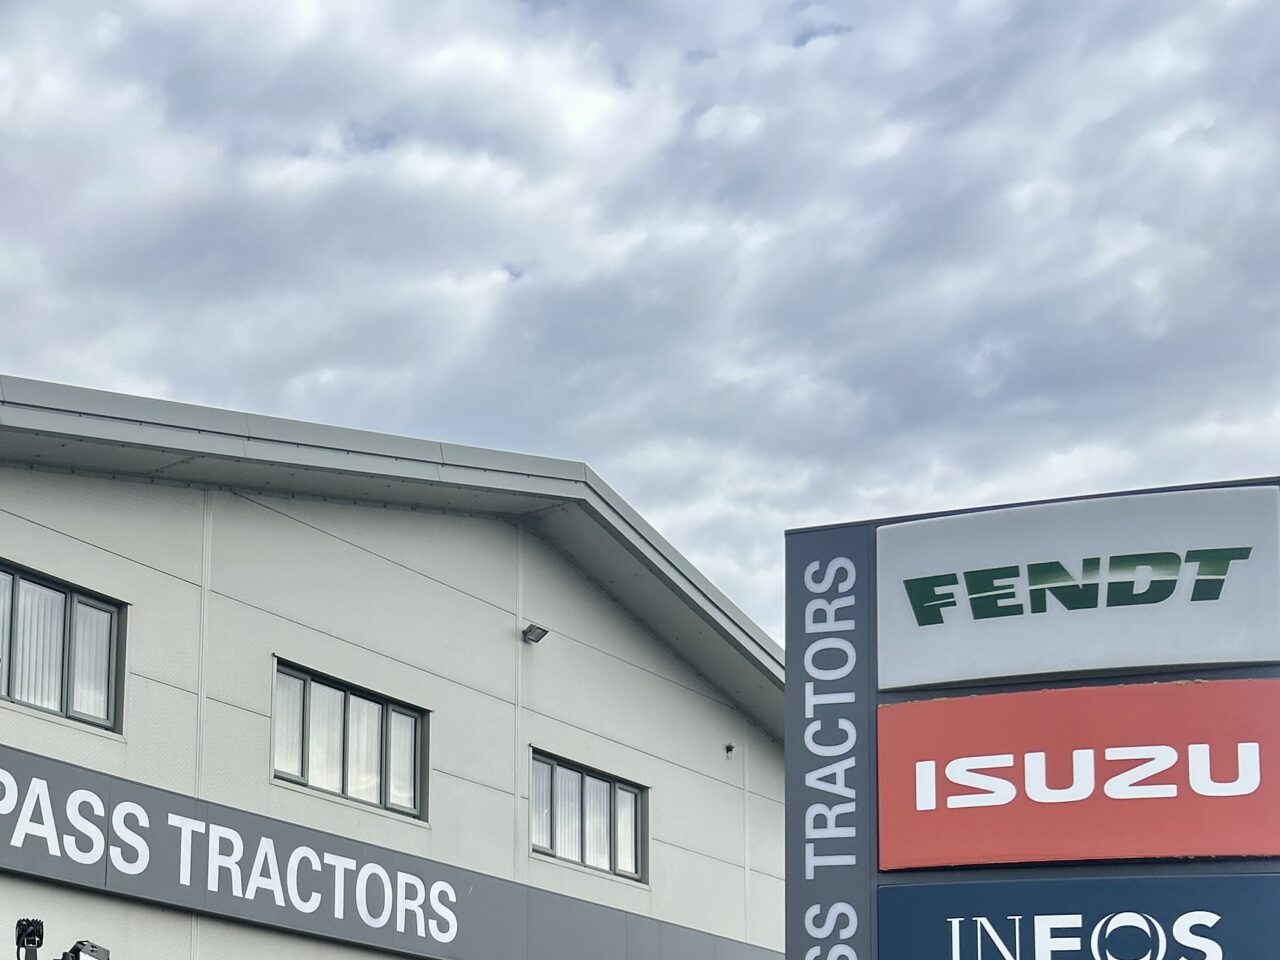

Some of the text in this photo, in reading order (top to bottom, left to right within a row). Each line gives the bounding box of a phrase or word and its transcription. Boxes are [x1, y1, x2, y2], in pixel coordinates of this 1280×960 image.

[903, 546, 1253, 627] FENDT
[804, 556, 857, 880] TRACTORS
[915, 742, 1261, 811] ISUZU
[167, 812, 459, 944] TRACTORS
